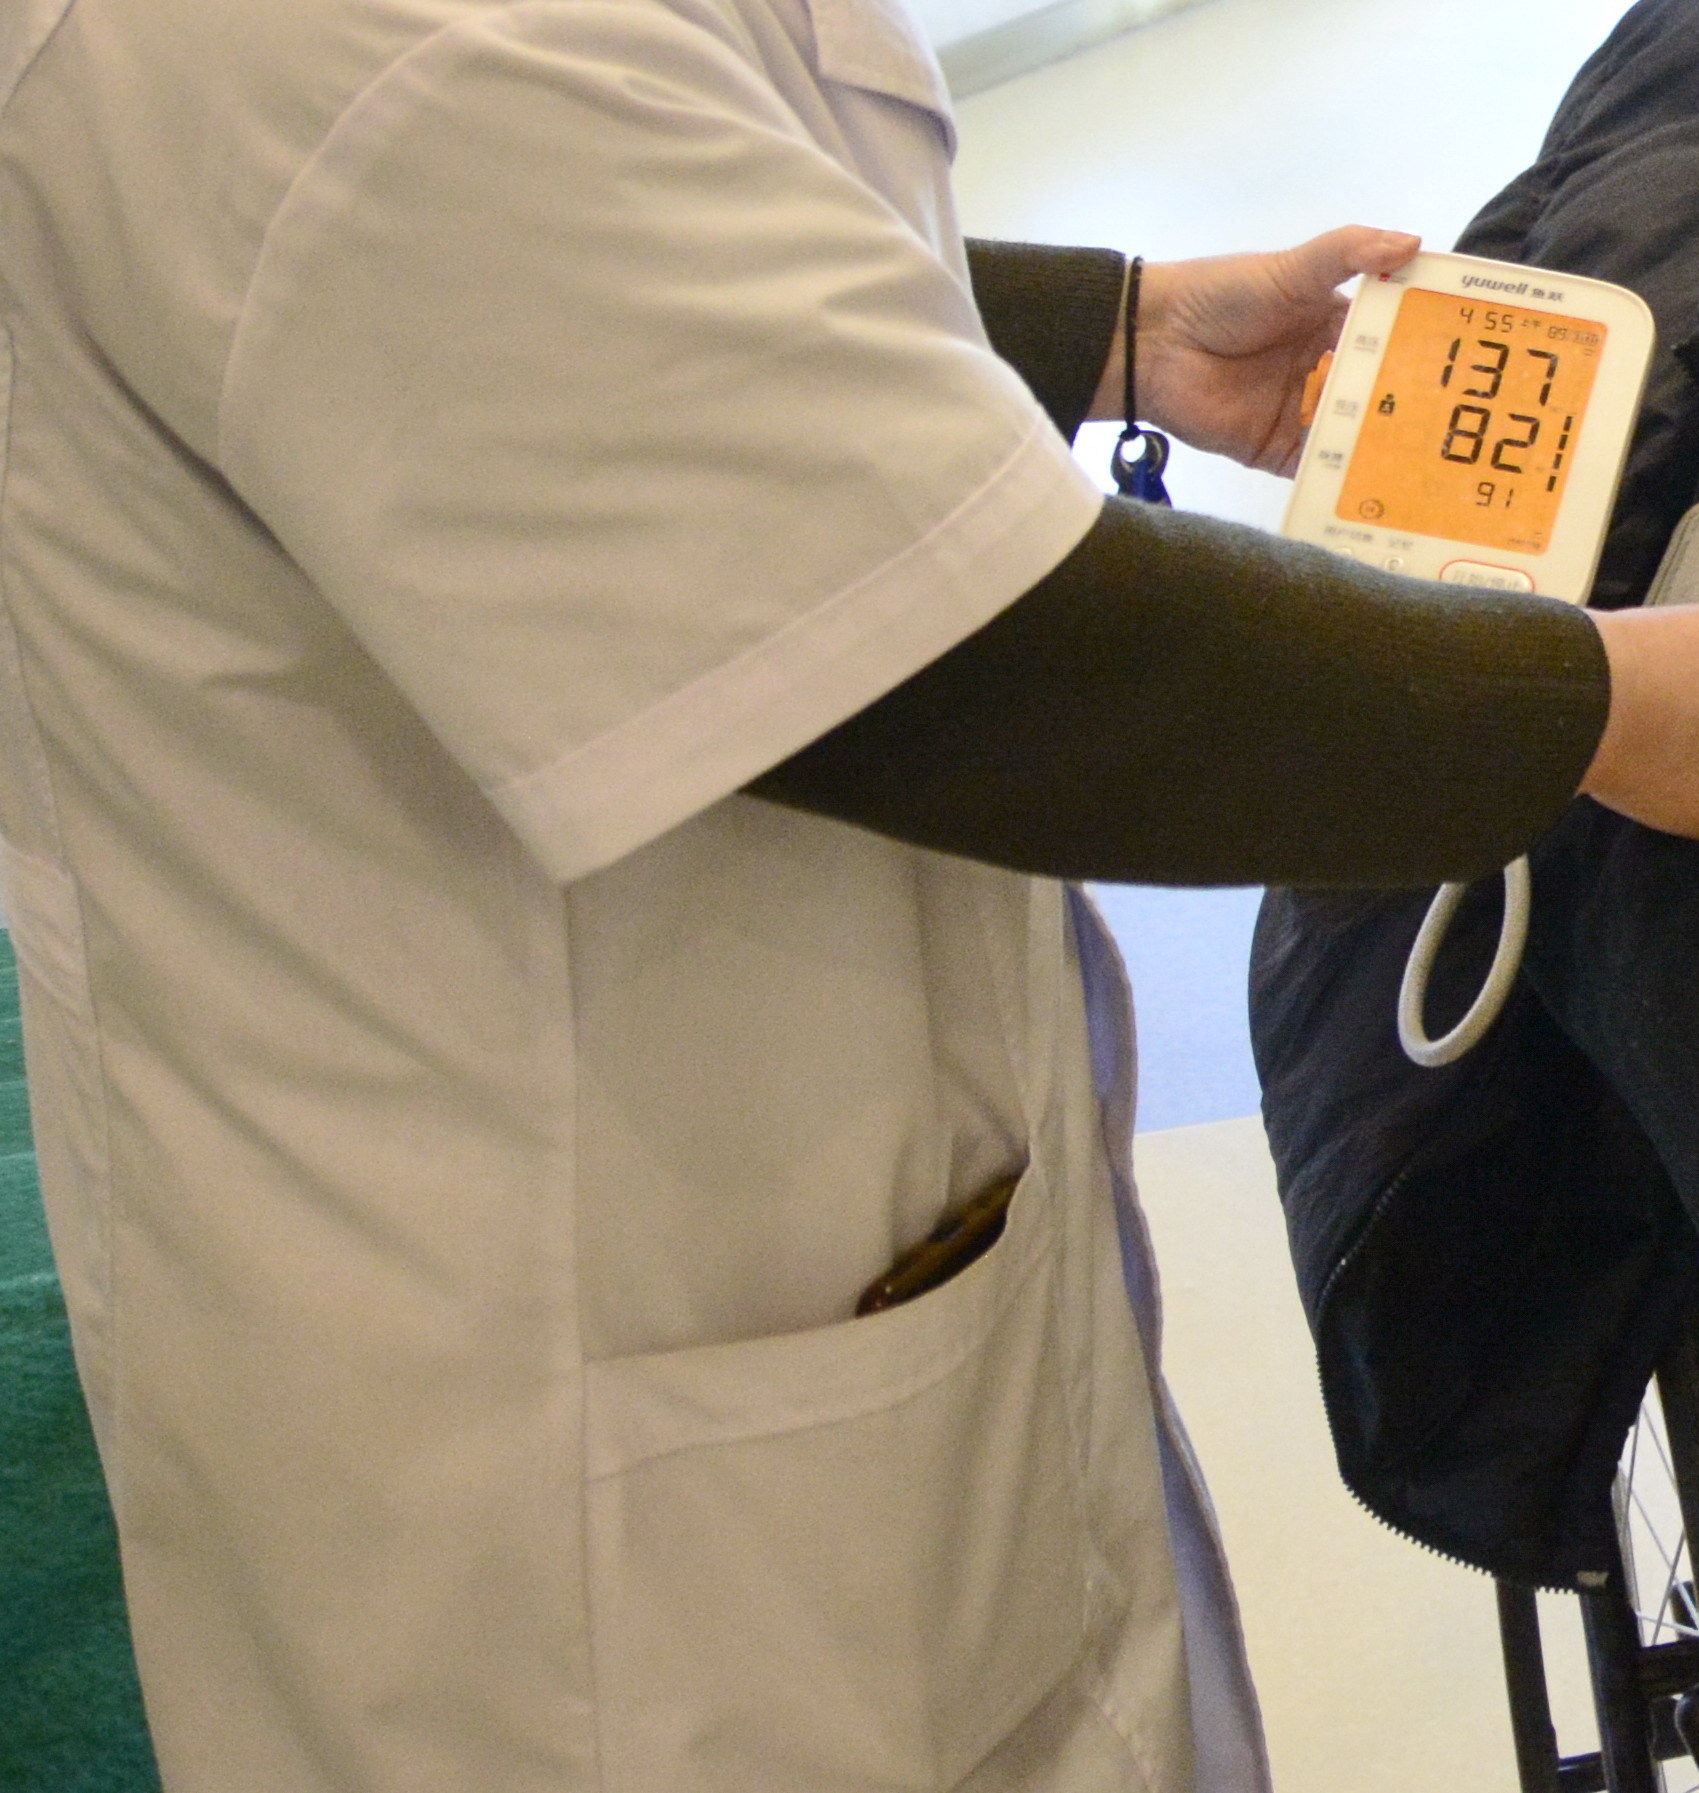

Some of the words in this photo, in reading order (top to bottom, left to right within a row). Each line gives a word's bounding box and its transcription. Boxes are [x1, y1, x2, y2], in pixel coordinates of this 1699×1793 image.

[1462, 274, 1529, 296] yuwell
[1441, 337, 1560, 407] 137
[1441, 403, 1541, 474] 82
[1475, 481, 1515, 509] 91
